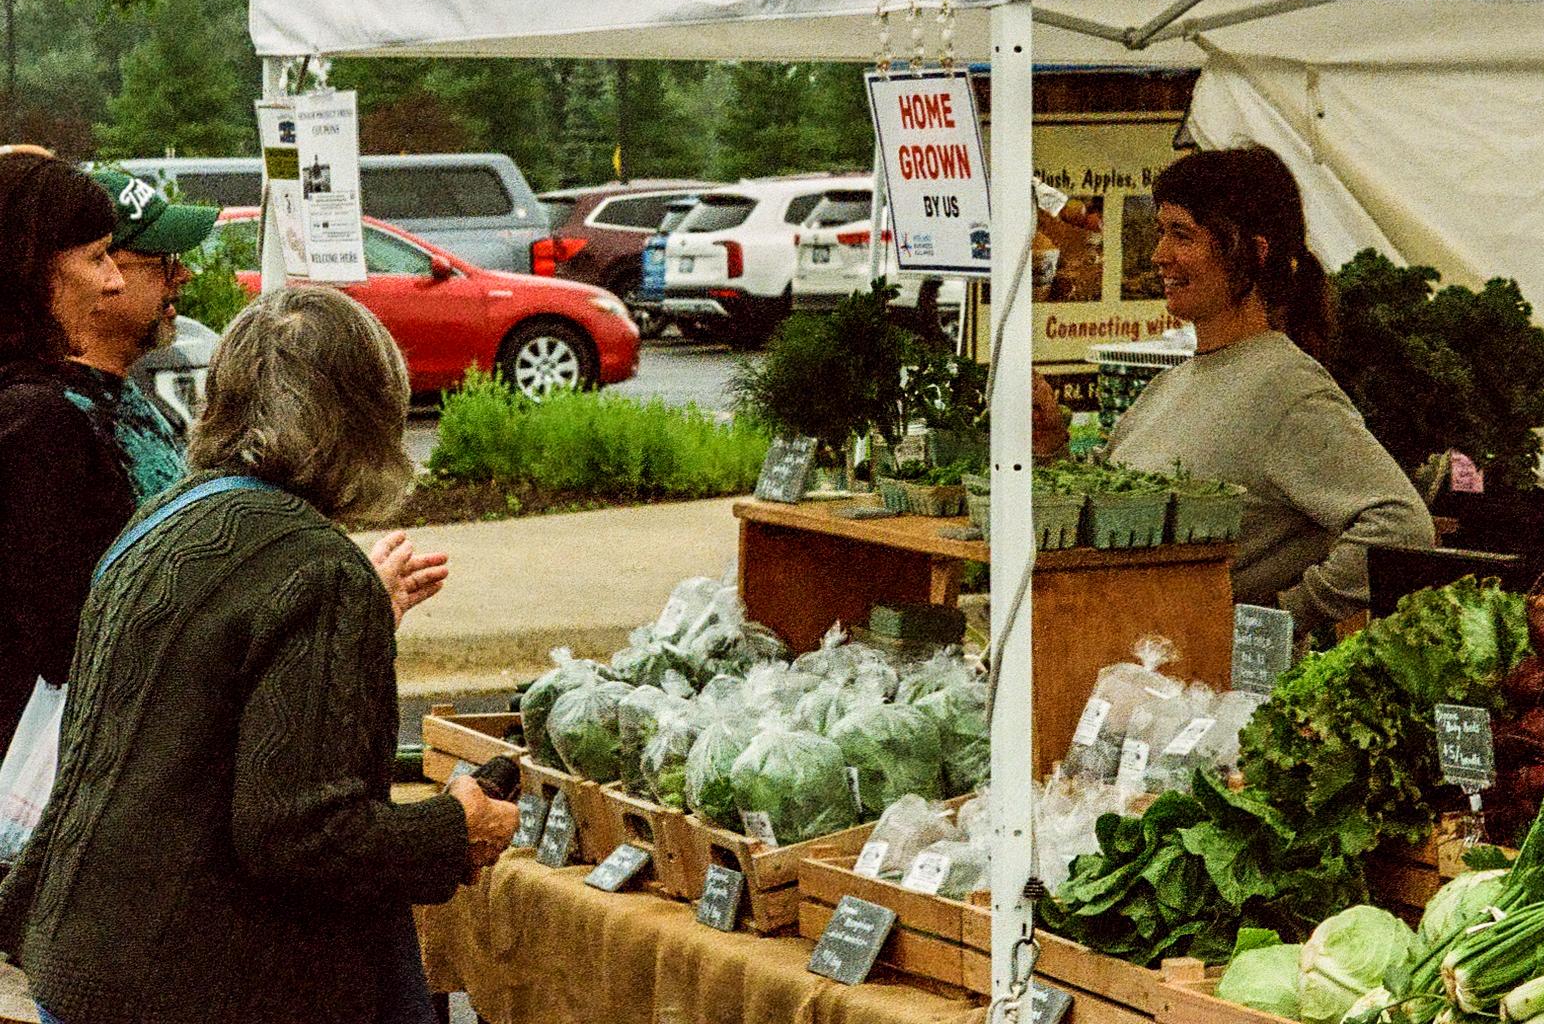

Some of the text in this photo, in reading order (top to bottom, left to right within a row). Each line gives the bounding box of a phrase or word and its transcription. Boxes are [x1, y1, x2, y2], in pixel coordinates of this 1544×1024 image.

[898, 93, 956, 130] HOME
[897, 144, 972, 180] GROWN
[923, 195, 960, 218] BY US
[1045, 315, 1140, 341] Connecting
